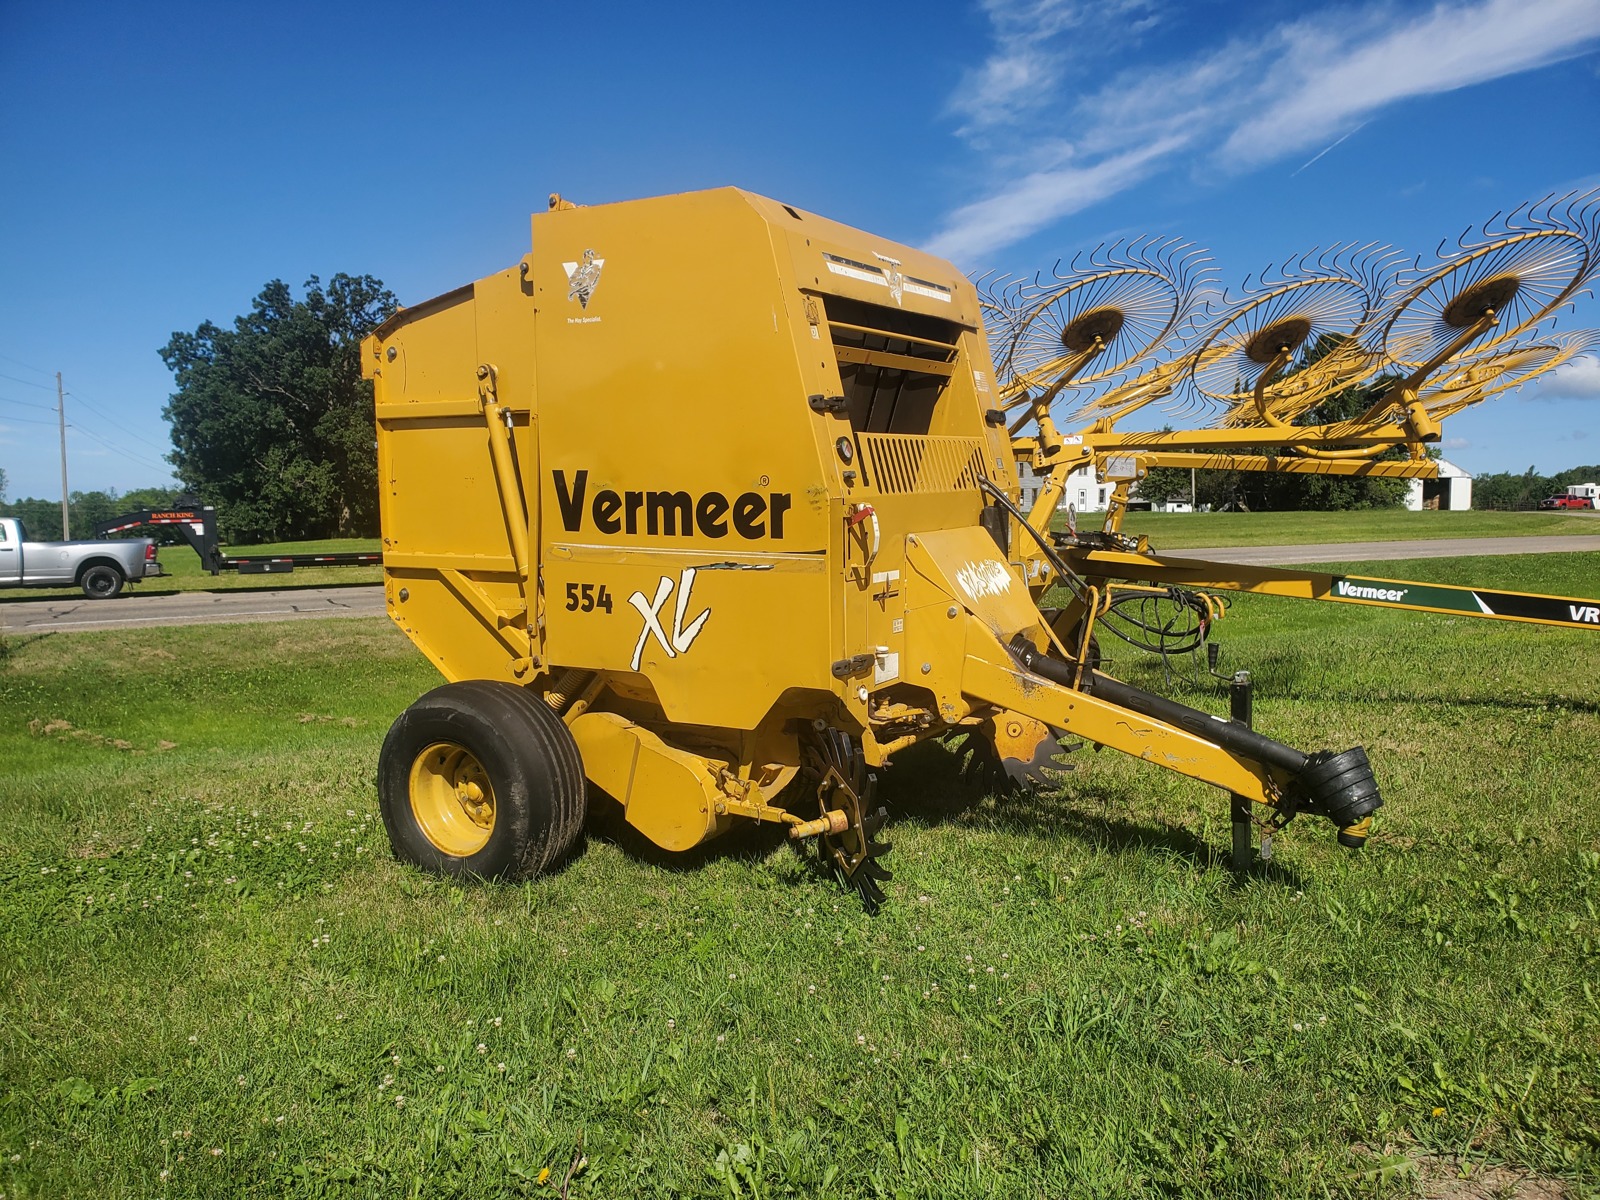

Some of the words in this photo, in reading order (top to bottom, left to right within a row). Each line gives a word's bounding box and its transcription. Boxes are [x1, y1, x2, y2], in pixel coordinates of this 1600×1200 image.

[552, 470, 791, 540] Vermeer
[565, 583, 613, 614] 554
[627, 567, 711, 672] XL
[1338, 581, 1401, 601] Vermeer
